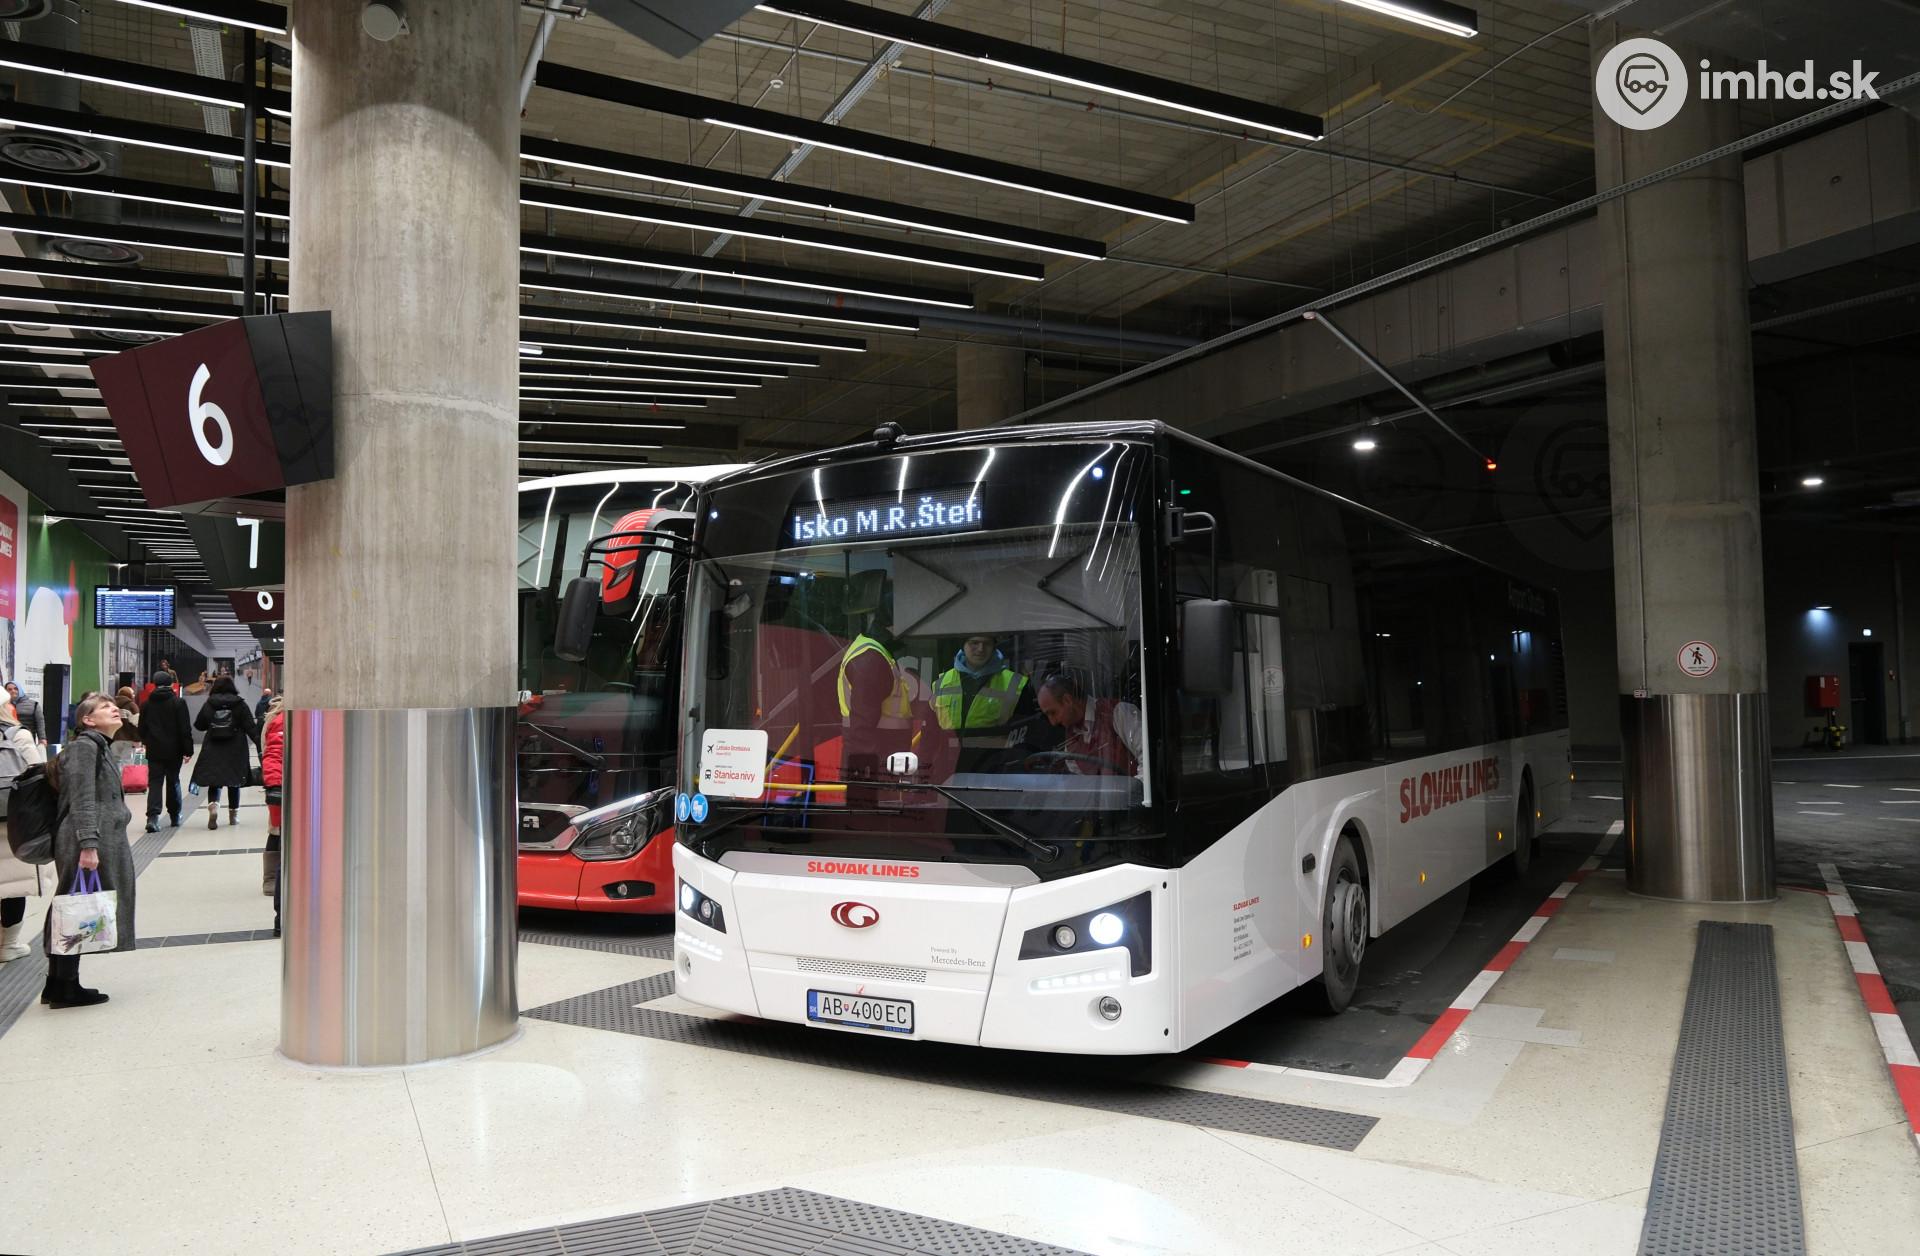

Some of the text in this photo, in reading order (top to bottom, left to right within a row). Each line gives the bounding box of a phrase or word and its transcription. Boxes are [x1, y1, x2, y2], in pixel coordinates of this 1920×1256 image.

[188, 362, 234, 466] 6
[794, 496, 981, 540] isko M.R.Štef
[236, 517, 259, 569] 7
[714, 769, 740, 780] Stanica
[1400, 755, 1500, 824] SLOVAK LINES
[807, 861, 920, 878] SLOVAK LINES
[931, 955, 987, 968] Mercedes-Benz
